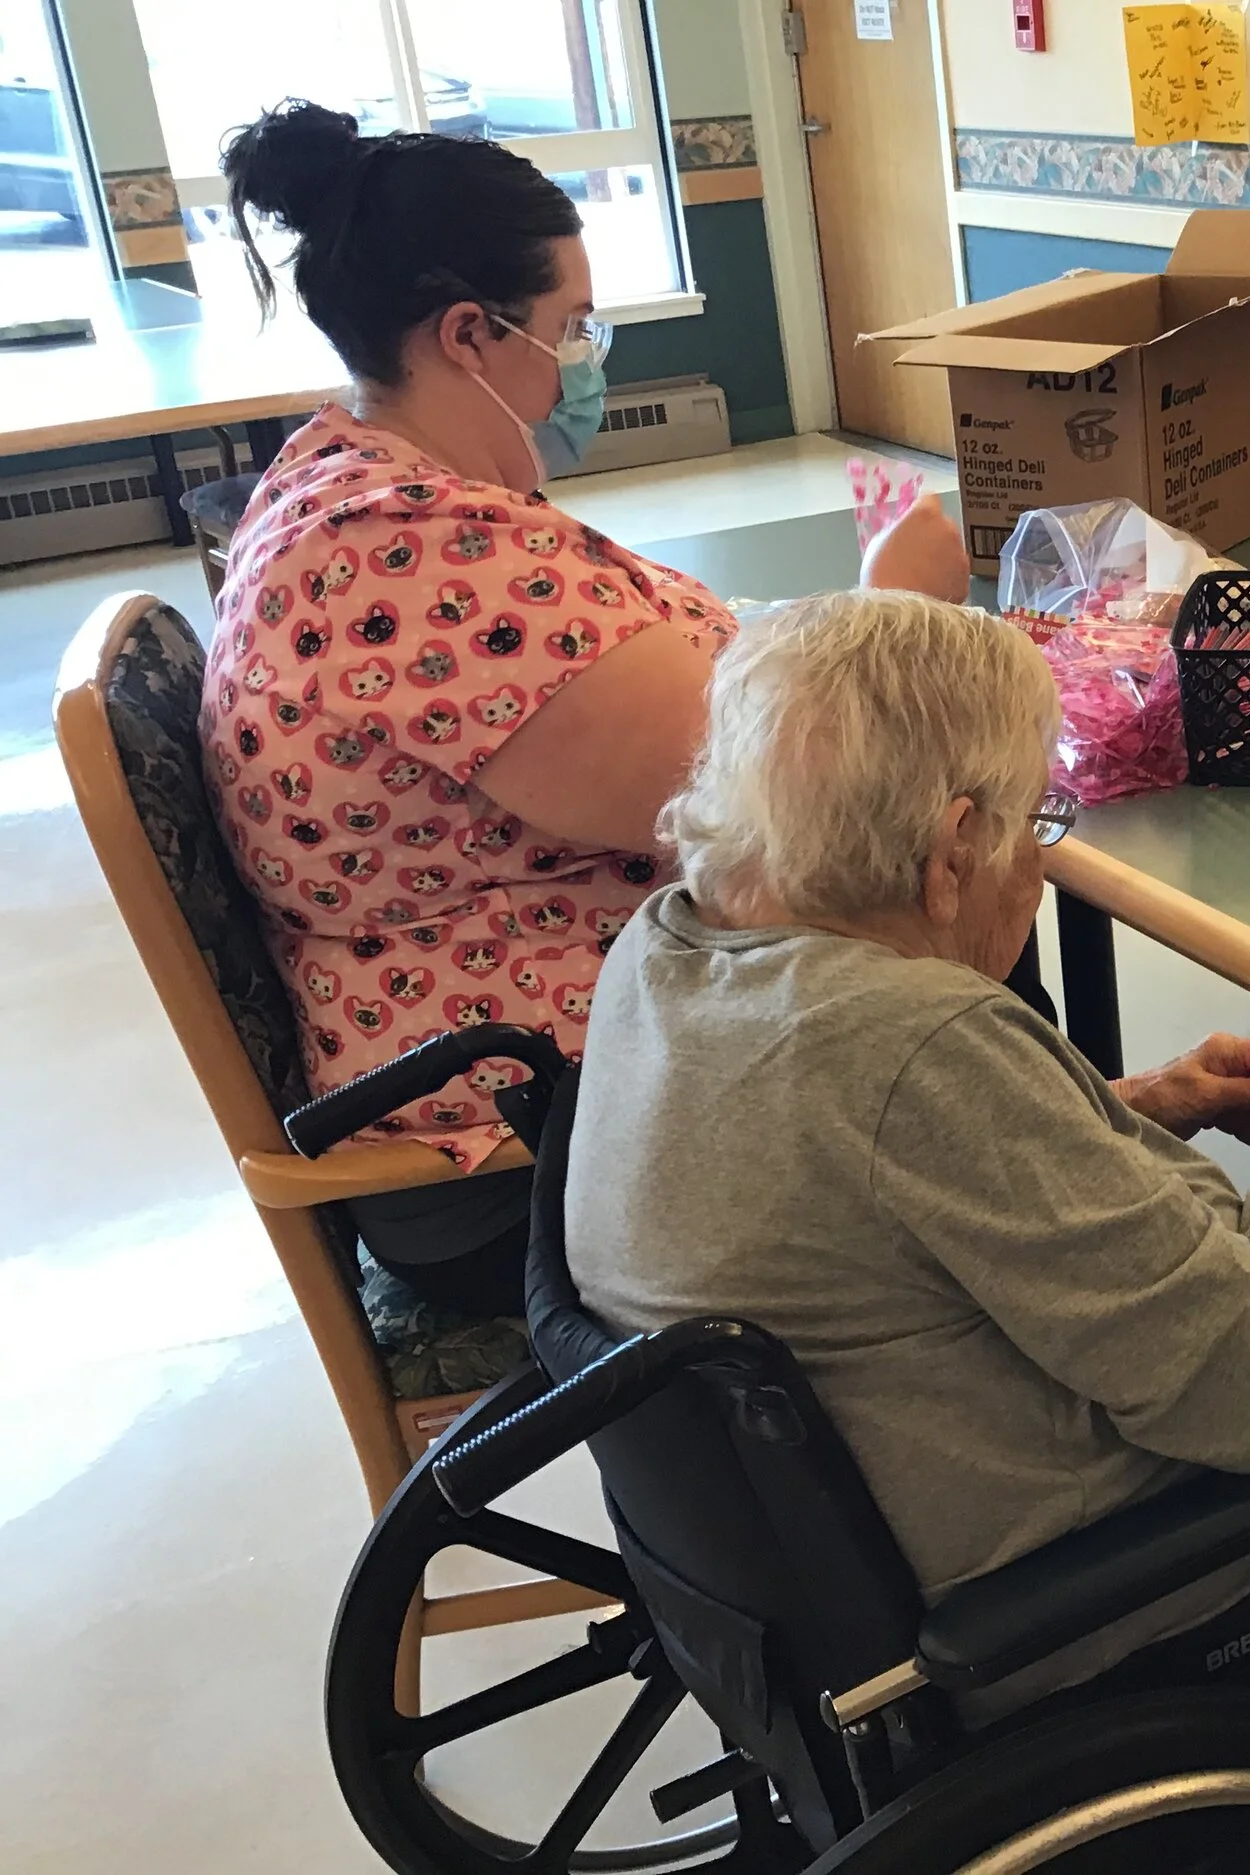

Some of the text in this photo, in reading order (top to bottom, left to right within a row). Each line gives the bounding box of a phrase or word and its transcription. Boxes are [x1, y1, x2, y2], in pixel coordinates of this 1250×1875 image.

[1173, 378, 1207, 405] Genpak
[973, 419, 1011, 431] Genpak
[1162, 422, 1176, 446] 12
[962, 439, 1003, 455] 12 oz.
[1163, 435, 1203, 472] Hinged
[963, 456, 1046, 475] Hinged Deli
[1165, 446, 1249, 500] Deli Containers
[964, 472, 1043, 491] Containers
